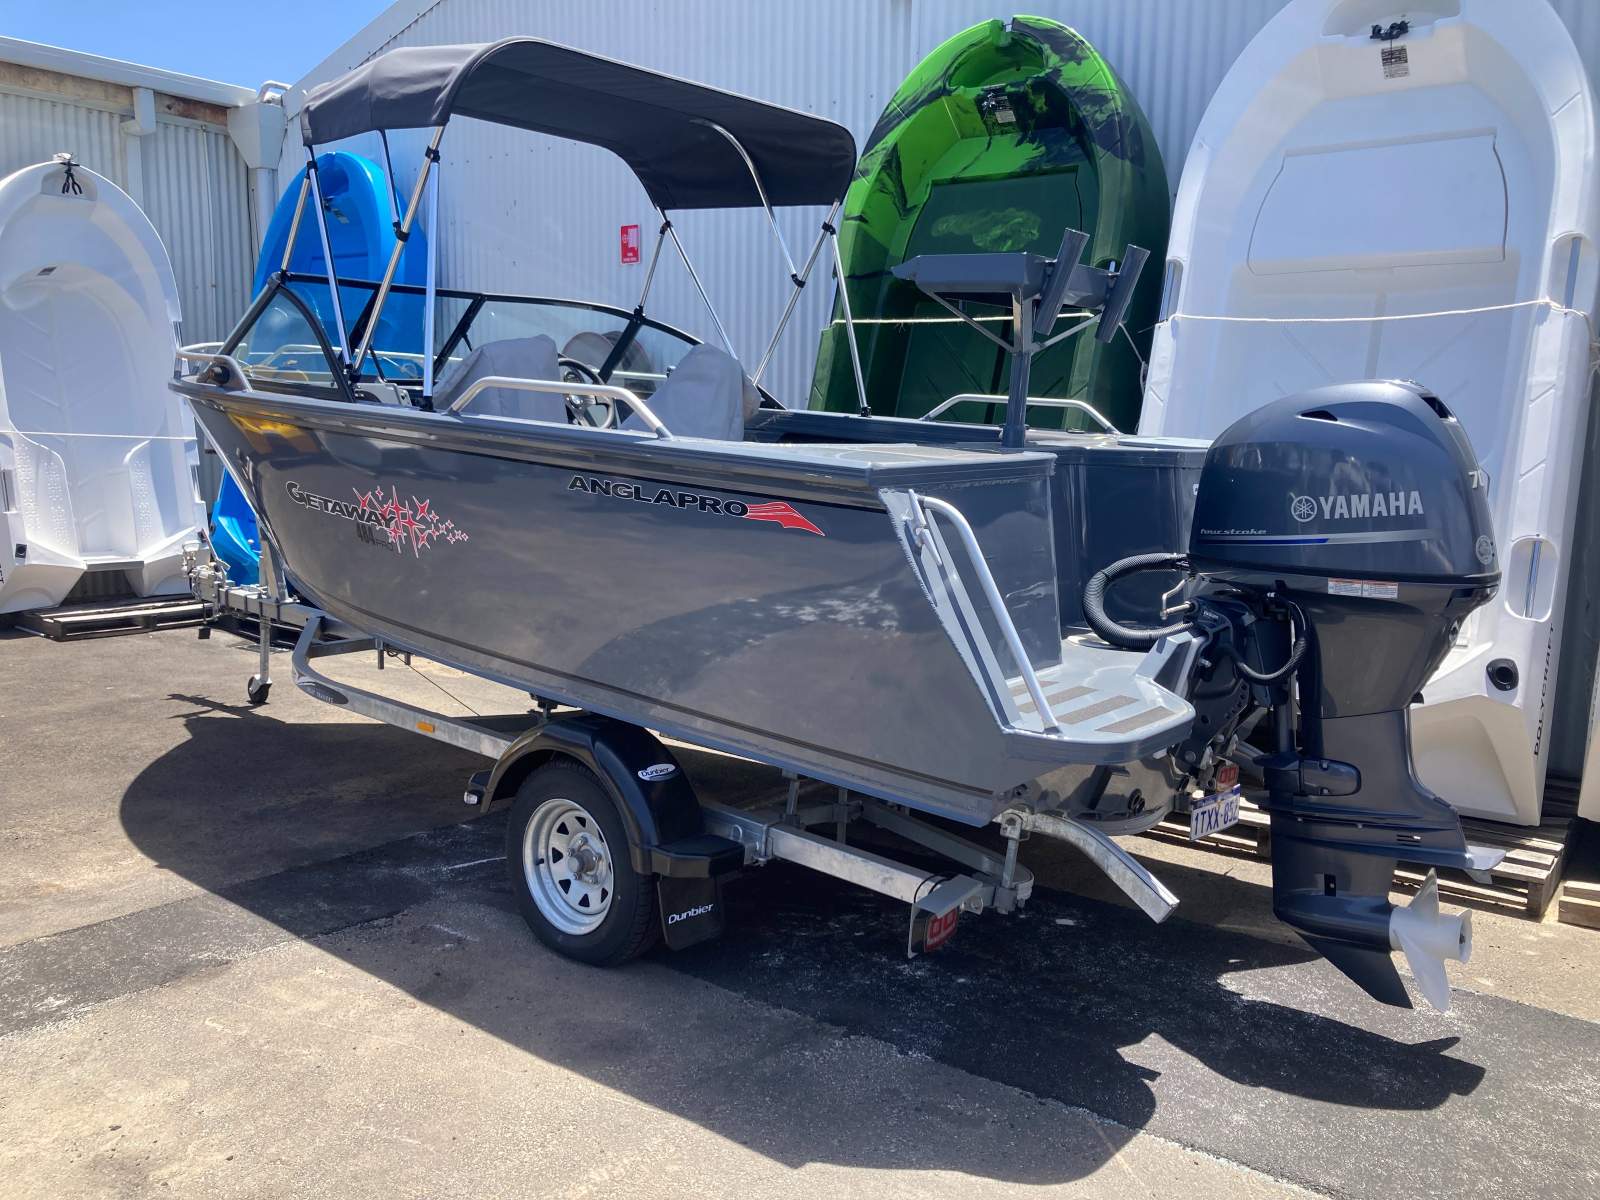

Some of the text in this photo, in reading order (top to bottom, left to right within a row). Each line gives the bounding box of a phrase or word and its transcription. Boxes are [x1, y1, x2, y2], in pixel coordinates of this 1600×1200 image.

[568, 475, 749, 518] ANGLAPRO
[1319, 490, 1425, 520] YAMAHA
[1534, 623, 1554, 756] POLYCRAFT
[668, 903, 714, 925] Dunbier
